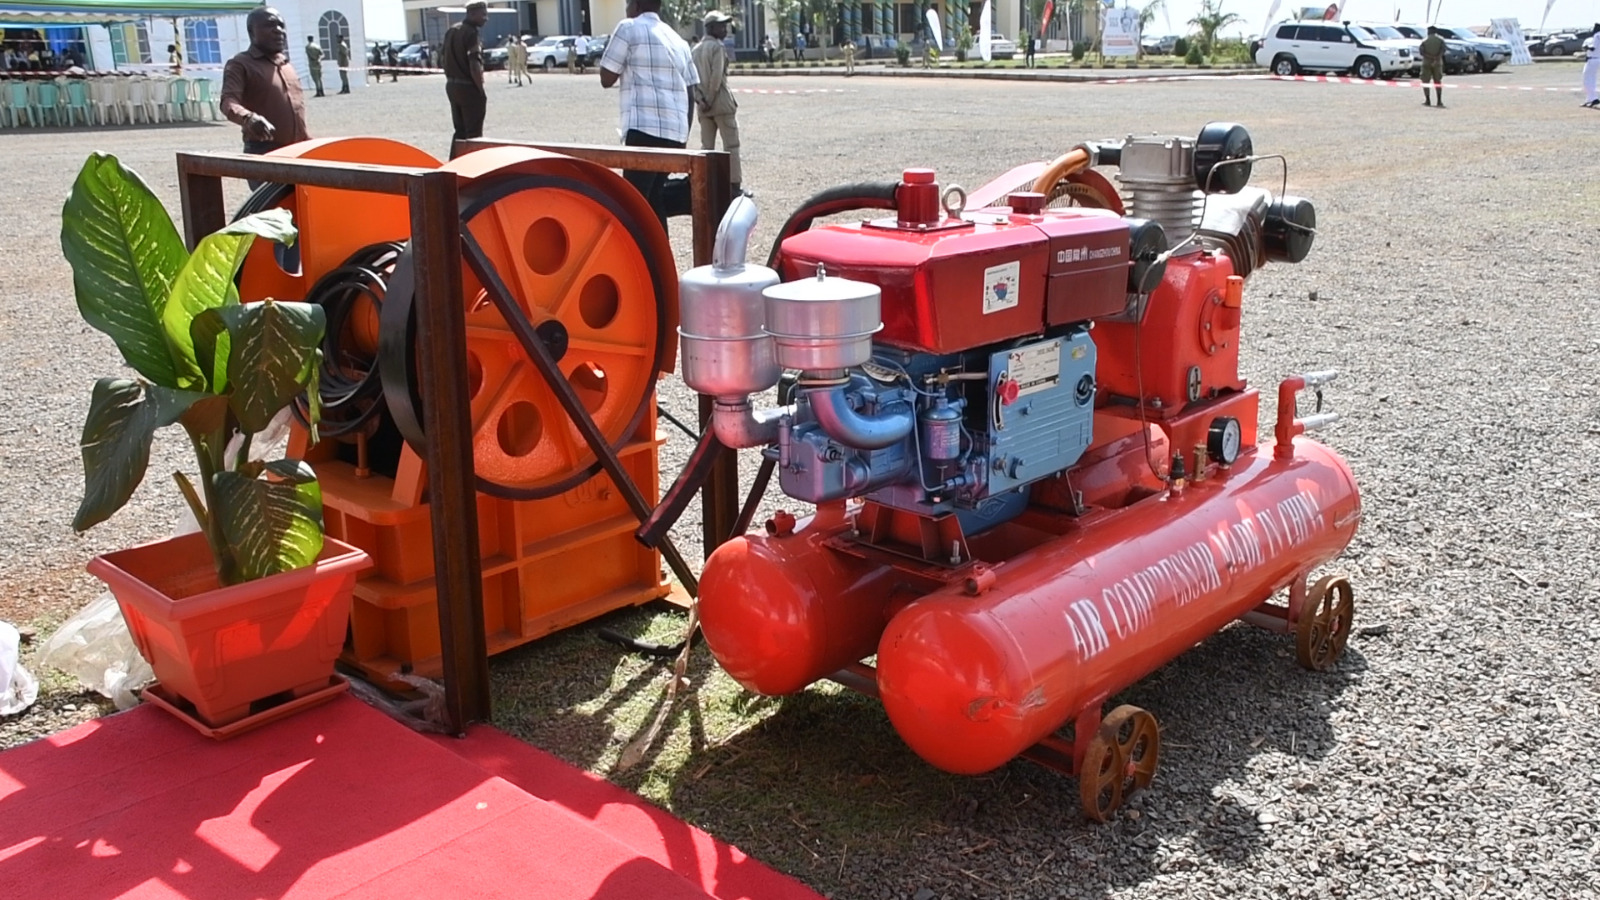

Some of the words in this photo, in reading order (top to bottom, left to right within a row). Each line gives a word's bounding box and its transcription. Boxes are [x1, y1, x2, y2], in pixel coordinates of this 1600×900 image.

[1064, 599, 1109, 662] AIR
[1211, 518, 1265, 573] MADE
[1256, 508, 1284, 558] IN
[1277, 489, 1325, 545] CHINA
